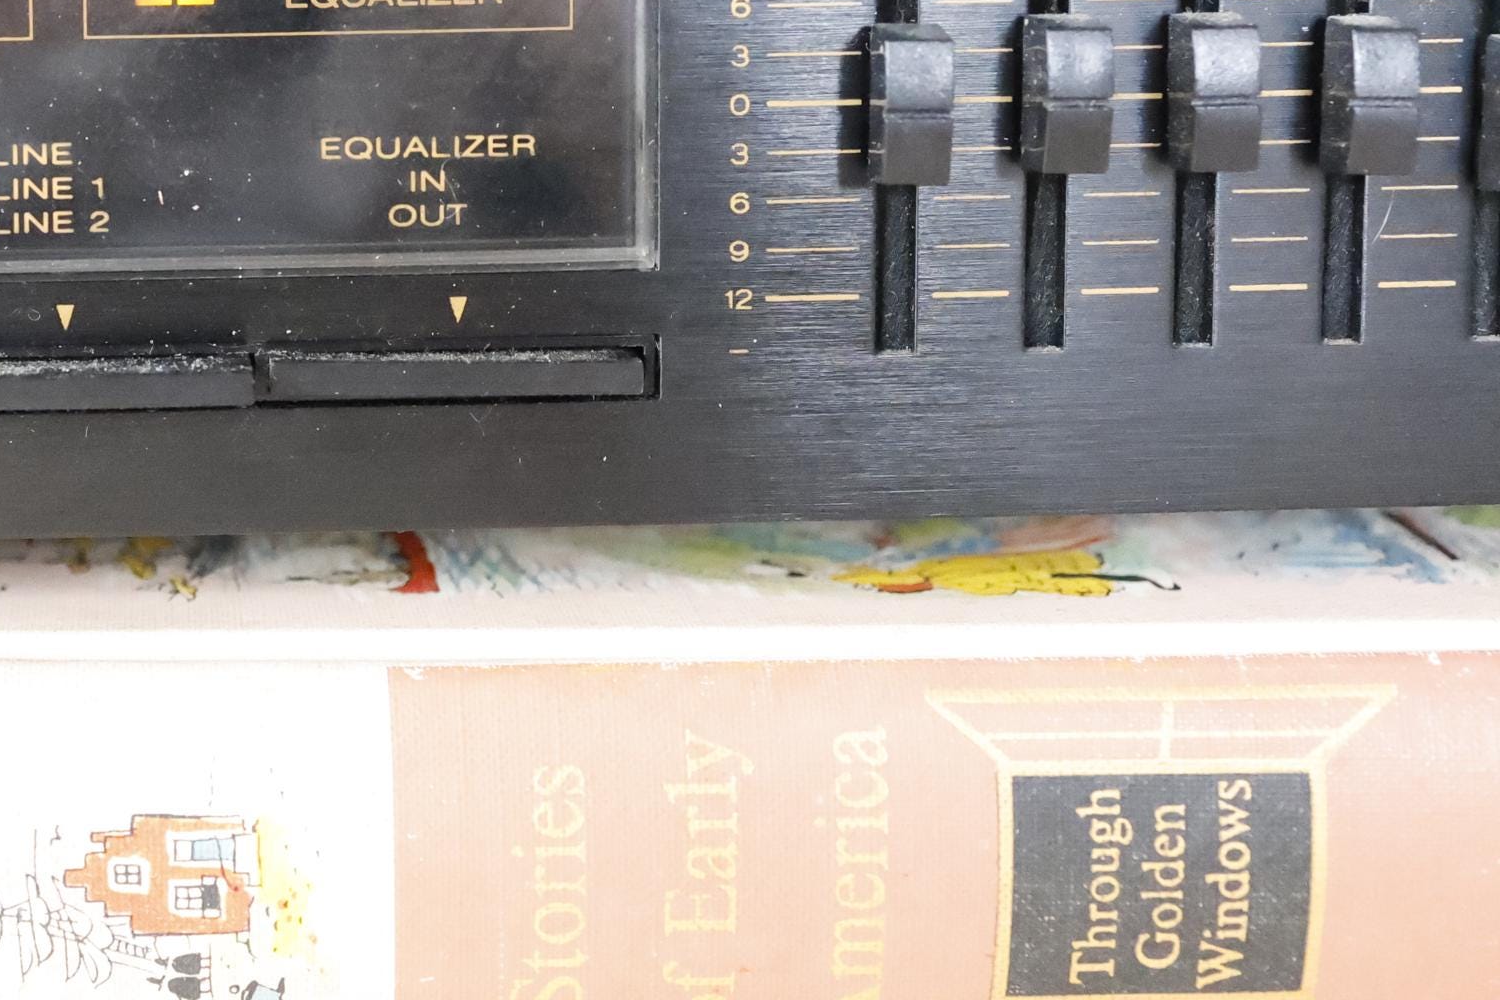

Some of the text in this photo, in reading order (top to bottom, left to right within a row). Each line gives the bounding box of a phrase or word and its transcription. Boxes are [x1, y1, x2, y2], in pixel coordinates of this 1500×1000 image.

[732, 45, 750, 68] 3
[729, 93, 751, 116] 0
[320, 134, 535, 160] EQUALIZER
[731, 143, 749, 166] 3
[92, 178, 103, 198] 1
[410, 170, 446, 192] IN
[730, 192, 750, 214] 6
[90, 211, 109, 232] 2
[388, 204, 467, 227] OUT
[729, 240, 750, 262] 9
[725, 289, 753, 310] 12
[662, 729, 755, 1000] f Early
[1068, 788, 1134, 986] Through
[1135, 803, 1187, 969] Golden
[1195, 778, 1252, 990] Windows
